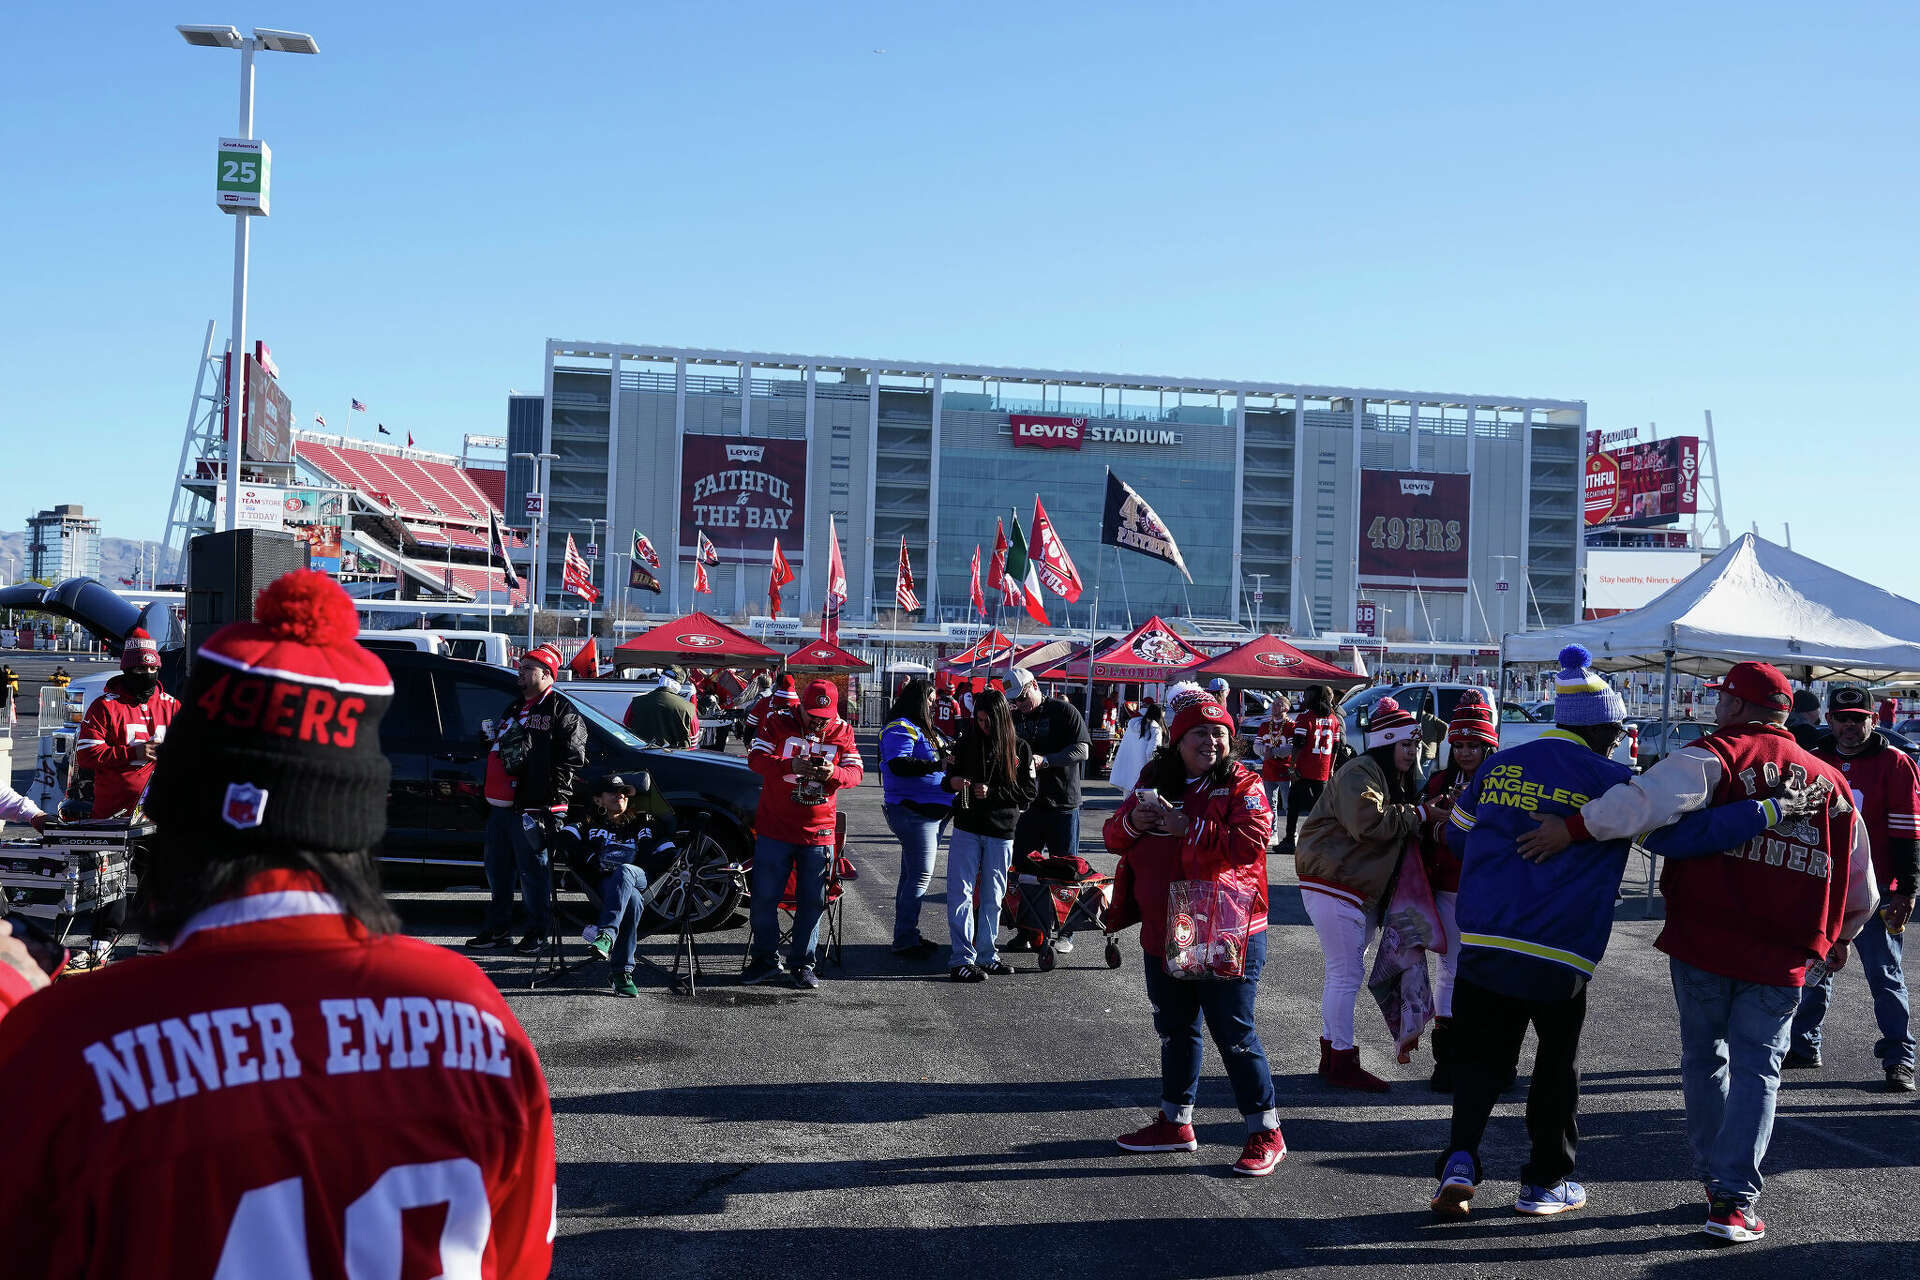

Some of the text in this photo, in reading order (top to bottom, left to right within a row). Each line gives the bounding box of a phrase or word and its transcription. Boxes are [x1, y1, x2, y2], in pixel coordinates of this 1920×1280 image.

[222, 160, 257, 183] 25
[1091, 426, 1176, 445] STADIUM
[693, 469, 793, 507] FAITHFUL
[1585, 470, 1616, 489] ITHFUL
[527, 500, 540, 509] 24
[692, 504, 793, 530] THE BAY
[1367, 516, 1462, 552] 49ERS
[1600, 575, 1614, 584] Stay
[1646, 575, 1669, 584] Niners
[755, 621, 799, 630] ticketmaster
[1343, 637, 1382, 645] ticketmaster
[197, 673, 367, 748] 49ERS
[939, 706, 950, 720] 19
[1312, 729, 1333, 754] 13
[1483, 764, 1523, 779] OS
[1722, 835, 1835, 879] NINER
[82, 996, 512, 1124] NINER EMPIRE
